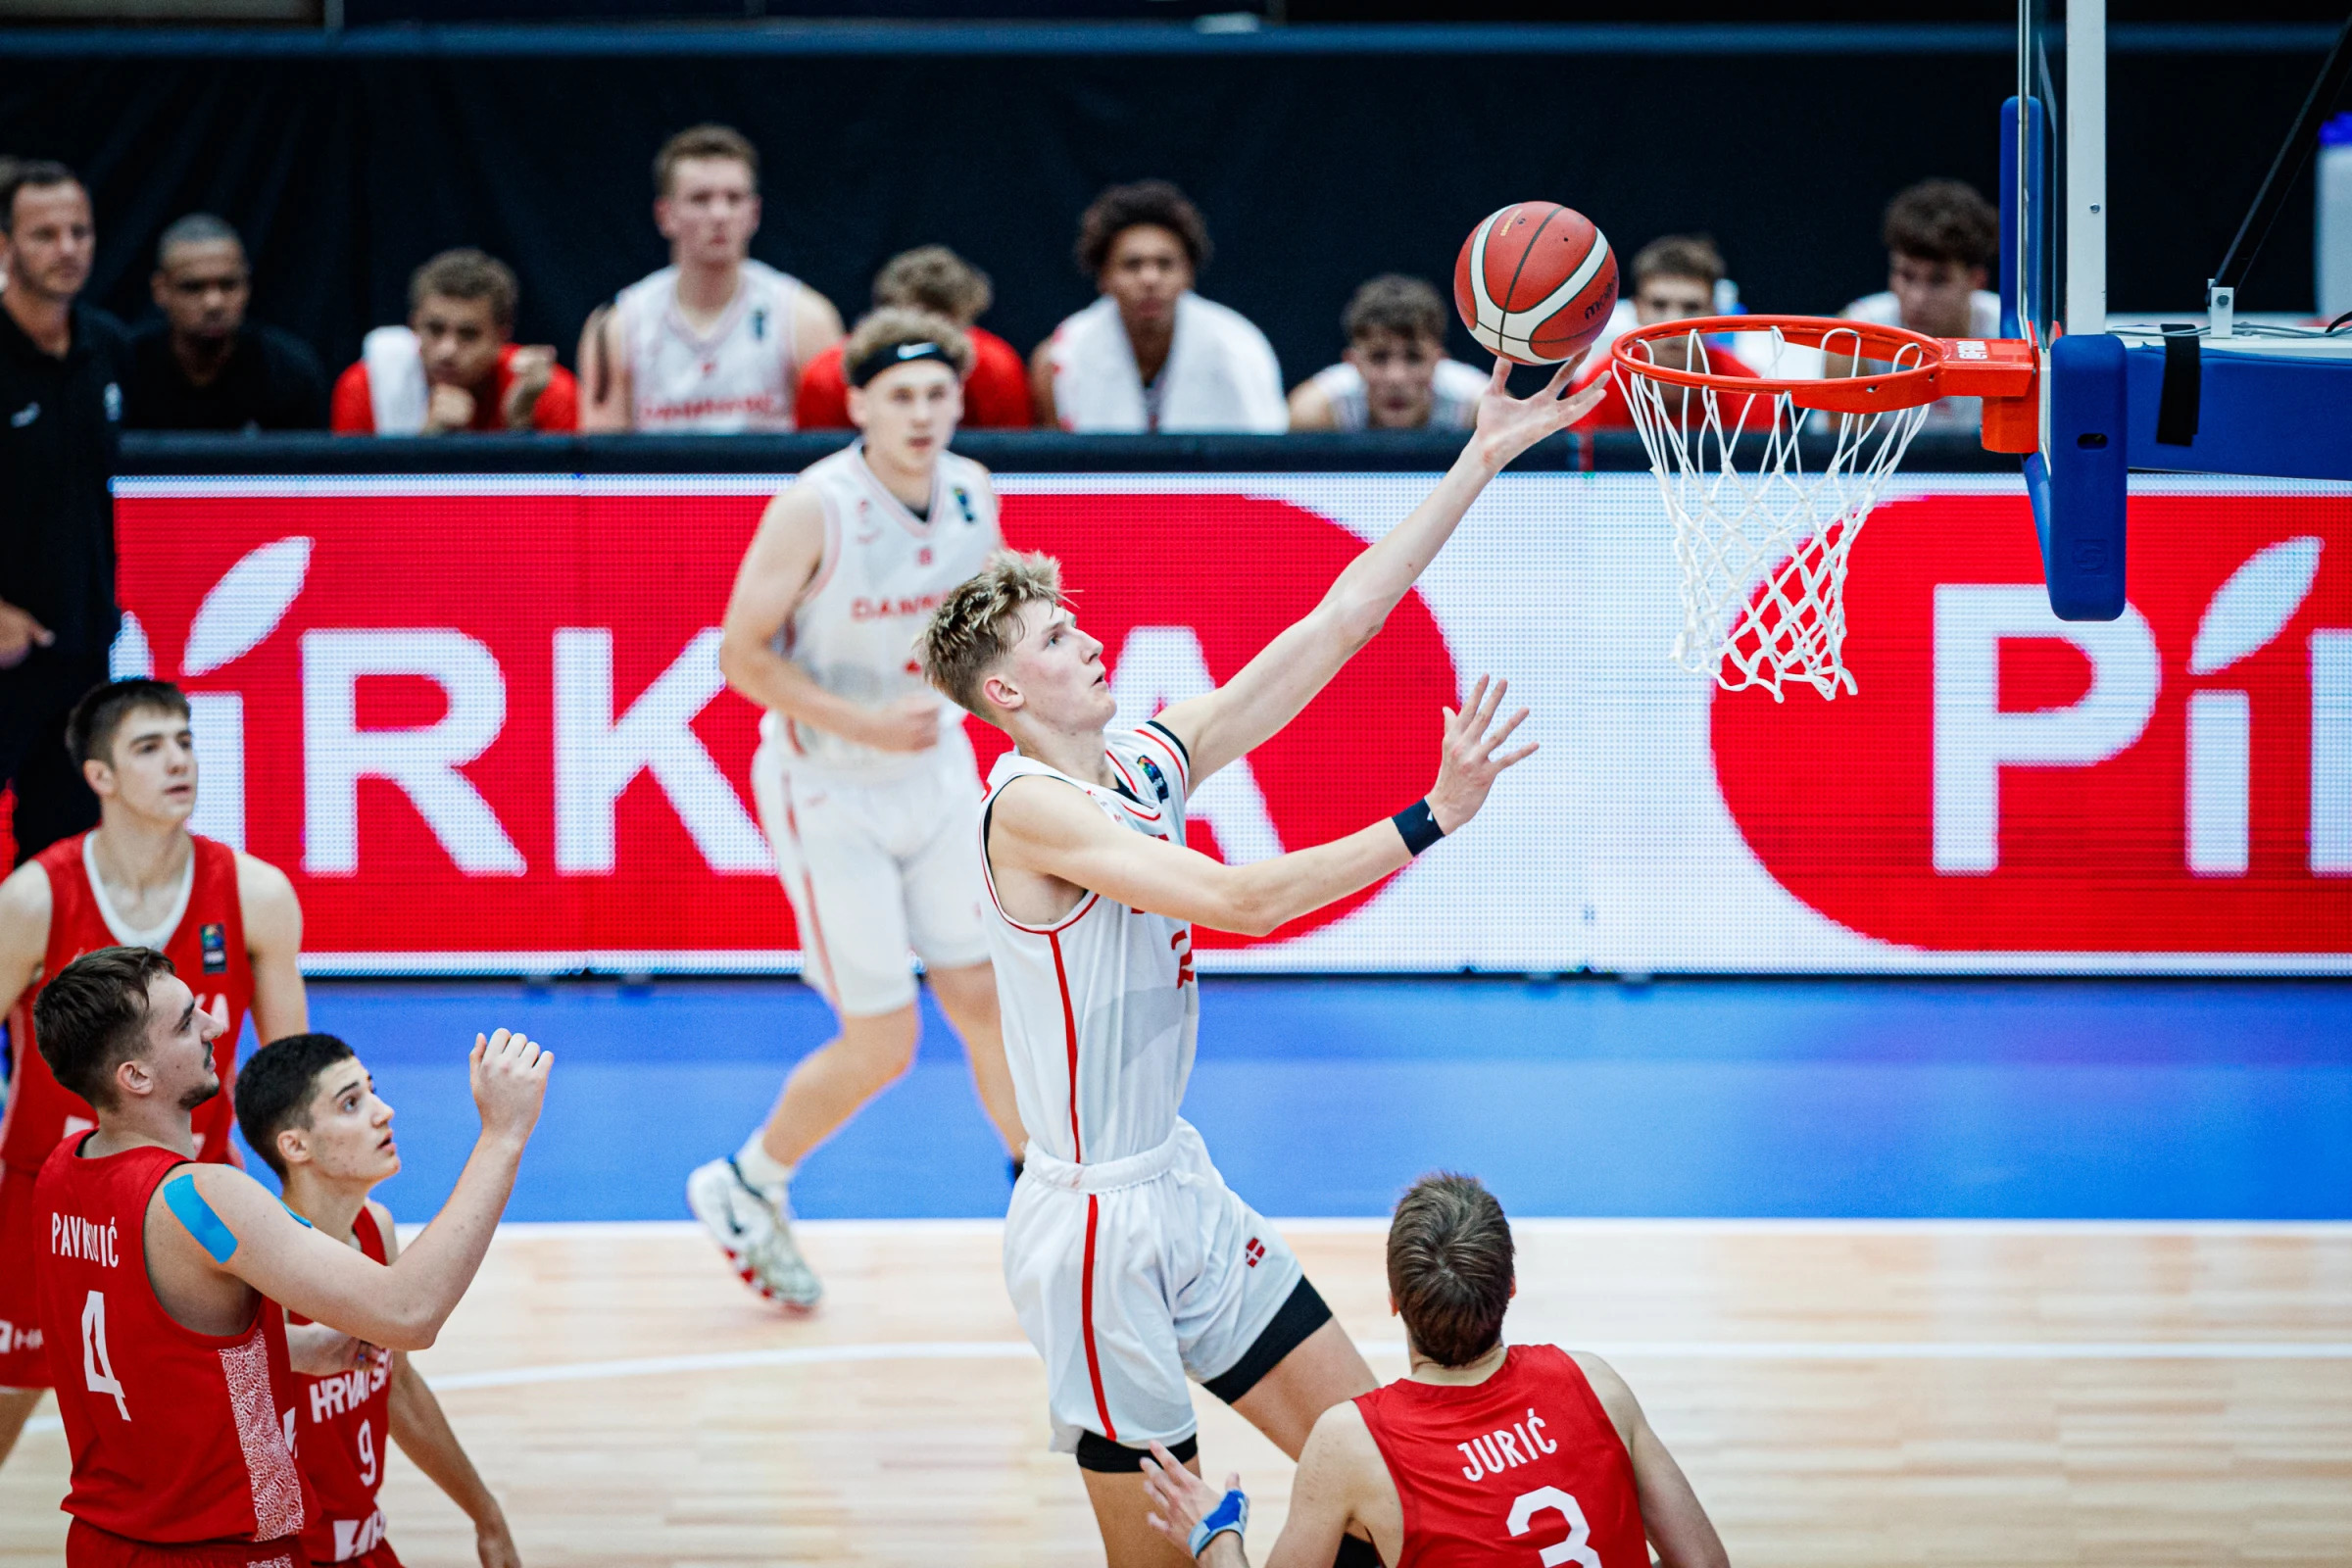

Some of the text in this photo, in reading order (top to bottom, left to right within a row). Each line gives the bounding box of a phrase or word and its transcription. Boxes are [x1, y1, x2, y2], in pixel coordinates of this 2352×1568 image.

[81, 1290, 131, 1422] 4
[357, 1418, 376, 1487] 9
[1456, 1407, 1558, 1482] JURIĆ
[1505, 1485, 1602, 1568] 3
